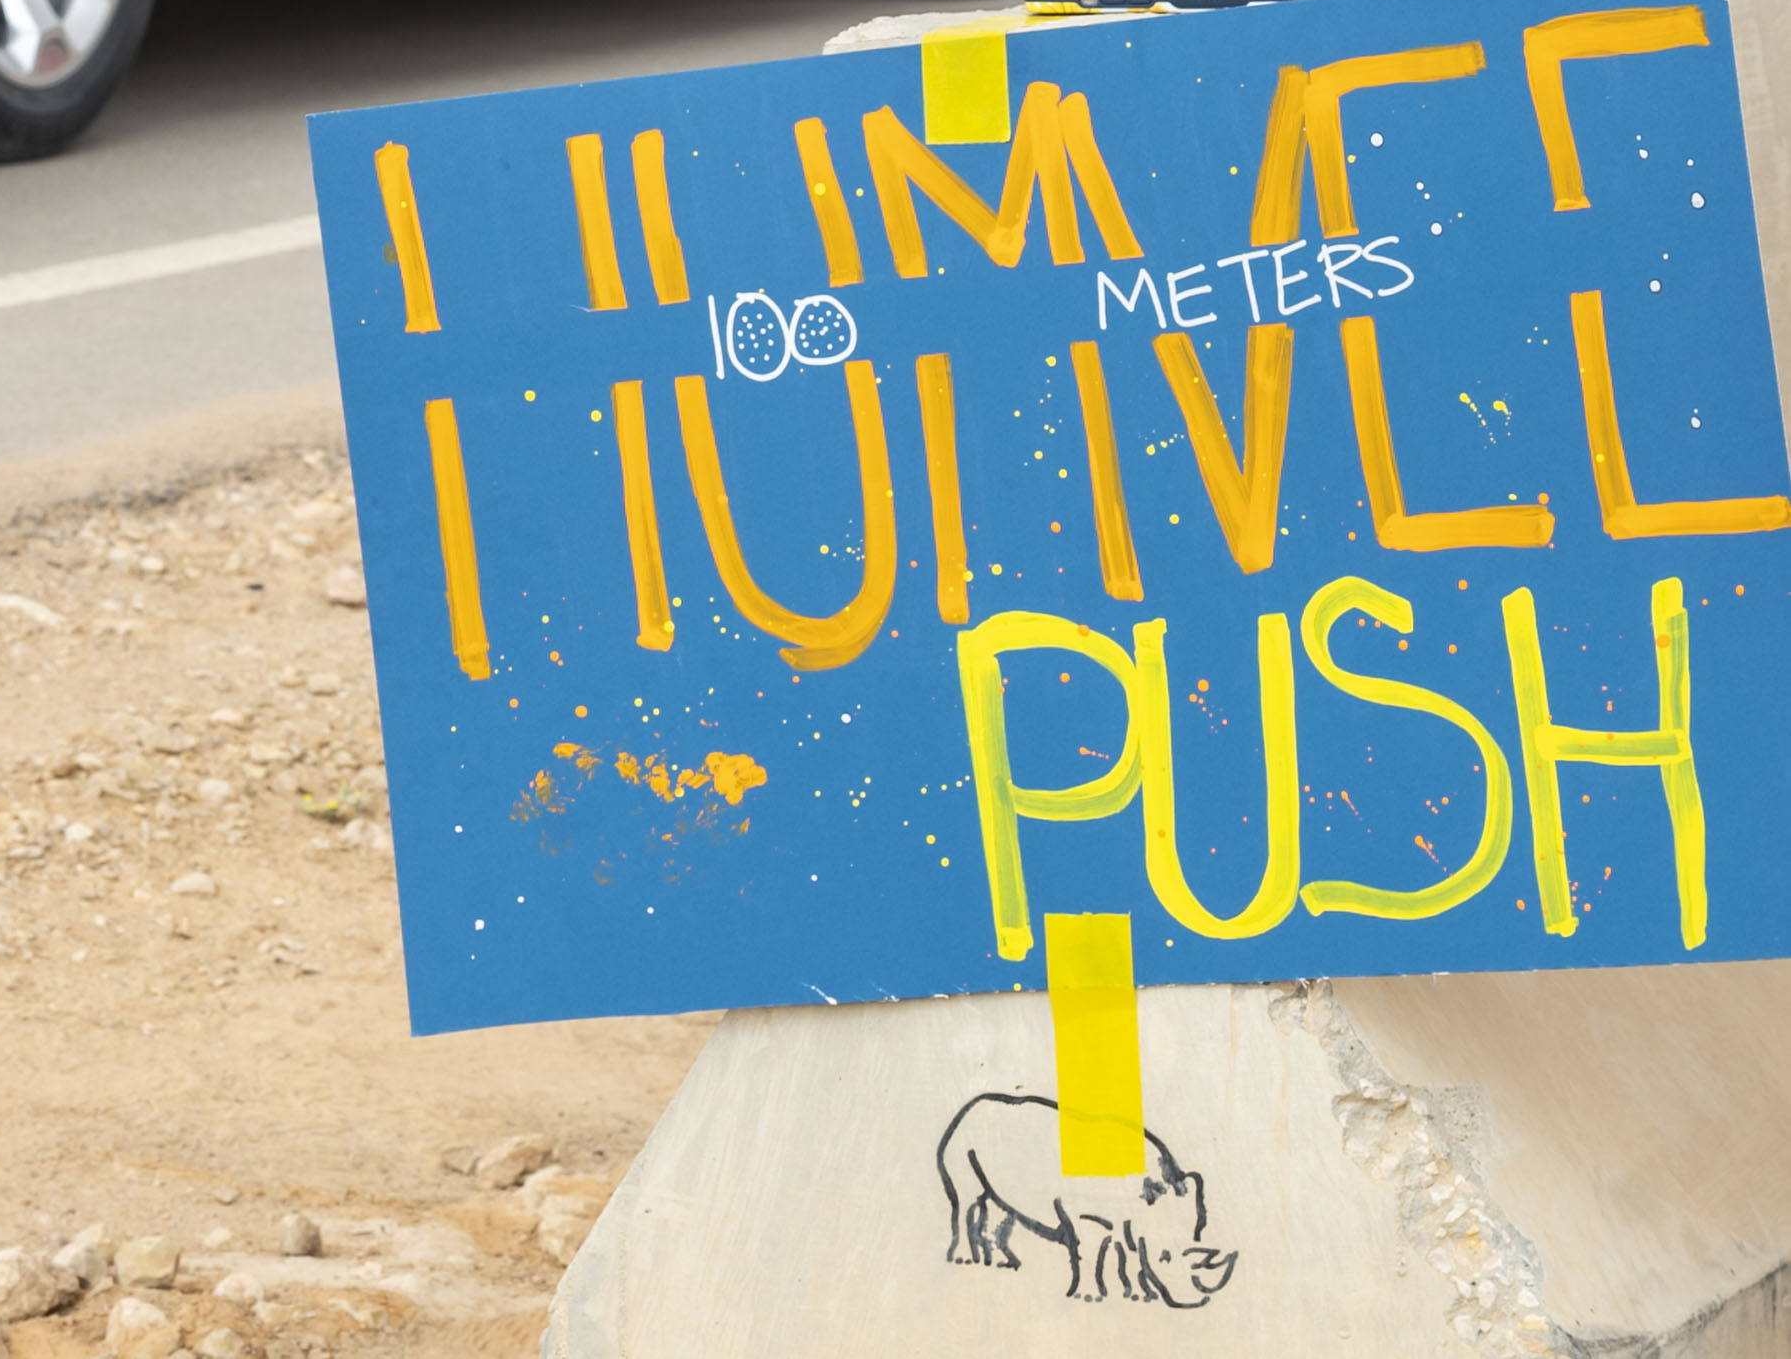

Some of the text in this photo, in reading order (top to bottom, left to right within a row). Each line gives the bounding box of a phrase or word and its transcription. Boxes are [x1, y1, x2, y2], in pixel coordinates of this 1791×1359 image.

[706, 234, 1415, 383] 100 METERS
[957, 575, 1708, 961] PUSH
